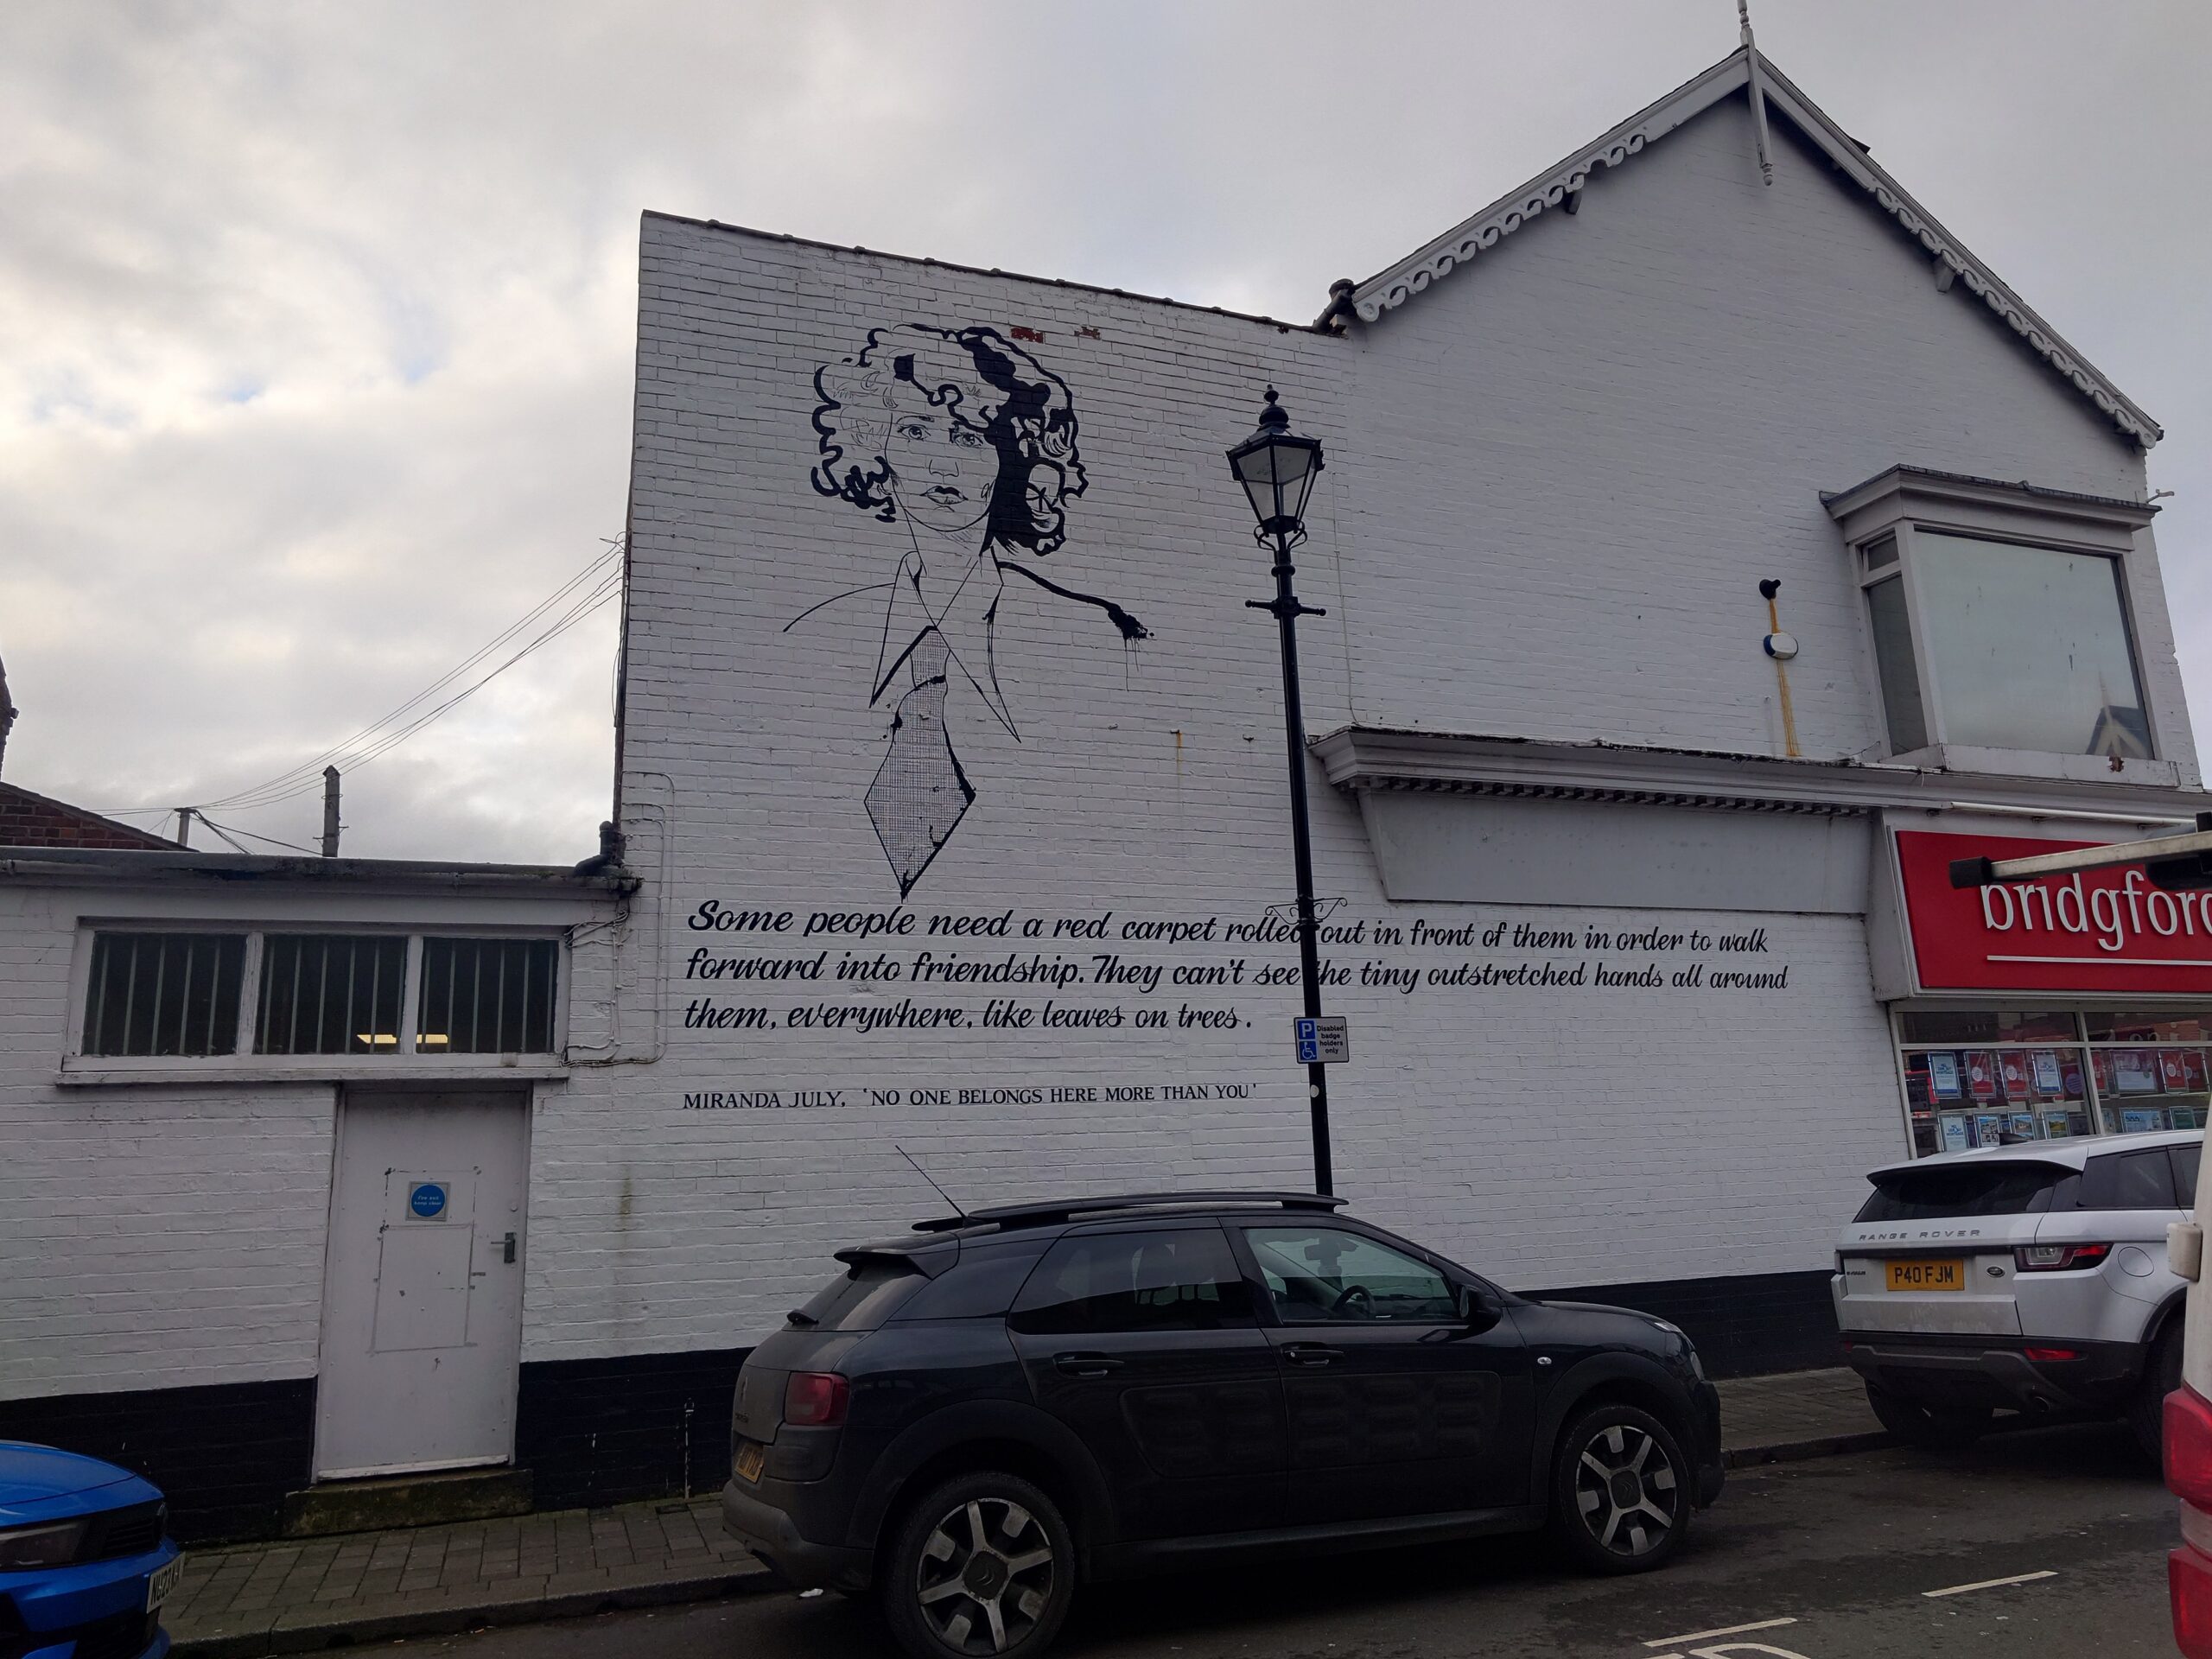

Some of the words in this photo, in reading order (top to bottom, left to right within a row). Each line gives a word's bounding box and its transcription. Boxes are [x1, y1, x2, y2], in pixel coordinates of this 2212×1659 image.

[689, 900, 793, 931] Some
[803, 906, 915, 938] people
[928, 910, 1014, 936] need
[1023, 918, 1043, 937] a
[1053, 912, 1112, 938] red
[1122, 918, 1217, 944] carpet
[1320, 920, 1366, 944] out
[1374, 920, 1403, 944] in
[1410, 919, 1474, 945] front
[1483, 922, 1507, 947] of
[1513, 923, 1577, 948] them
[1585, 925, 1611, 949] in
[1617, 926, 1683, 950] order
[1690, 931, 1712, 950] to
[1719, 929, 1767, 952] walk
[686, 948, 827, 980] forward
[836, 952, 900, 981] into
[912, 952, 1084, 989] friendship.
[1092, 955, 1162, 993] They
[1173, 959, 1244, 984] can't
[1253, 965, 1300, 985] see
[1361, 961, 1420, 994] tiny
[1428, 962, 1587, 986] outstretched
[1595, 963, 1662, 987] hands
[1673, 964, 1702, 987] all
[1710, 966, 1788, 988] around
[685, 998, 776, 1029] them,
[788, 999, 972, 1033] everywhere,
[983, 1000, 1035, 1027] like
[1043, 1001, 1125, 1027] leaves
[1135, 1010, 1168, 1027] on
[1179, 1004, 1250, 1028] trees.
[683, 1093, 781, 1109] MIRANDA
[789, 1091, 845, 1107] JULY,
[910, 1090, 950, 1105] ONE
[959, 1090, 1042, 1104] BELONGS
[1051, 1089, 1096, 1103] HERE
[1106, 1087, 1154, 1101] MORE
[1161, 1086, 1207, 1099] THAN
[1859, 1232, 1908, 1241] RANGE
[1919, 1230, 1980, 1238] ROVER
[1895, 1266, 1922, 1284] P40
[1925, 1265, 1954, 1283] FJM
